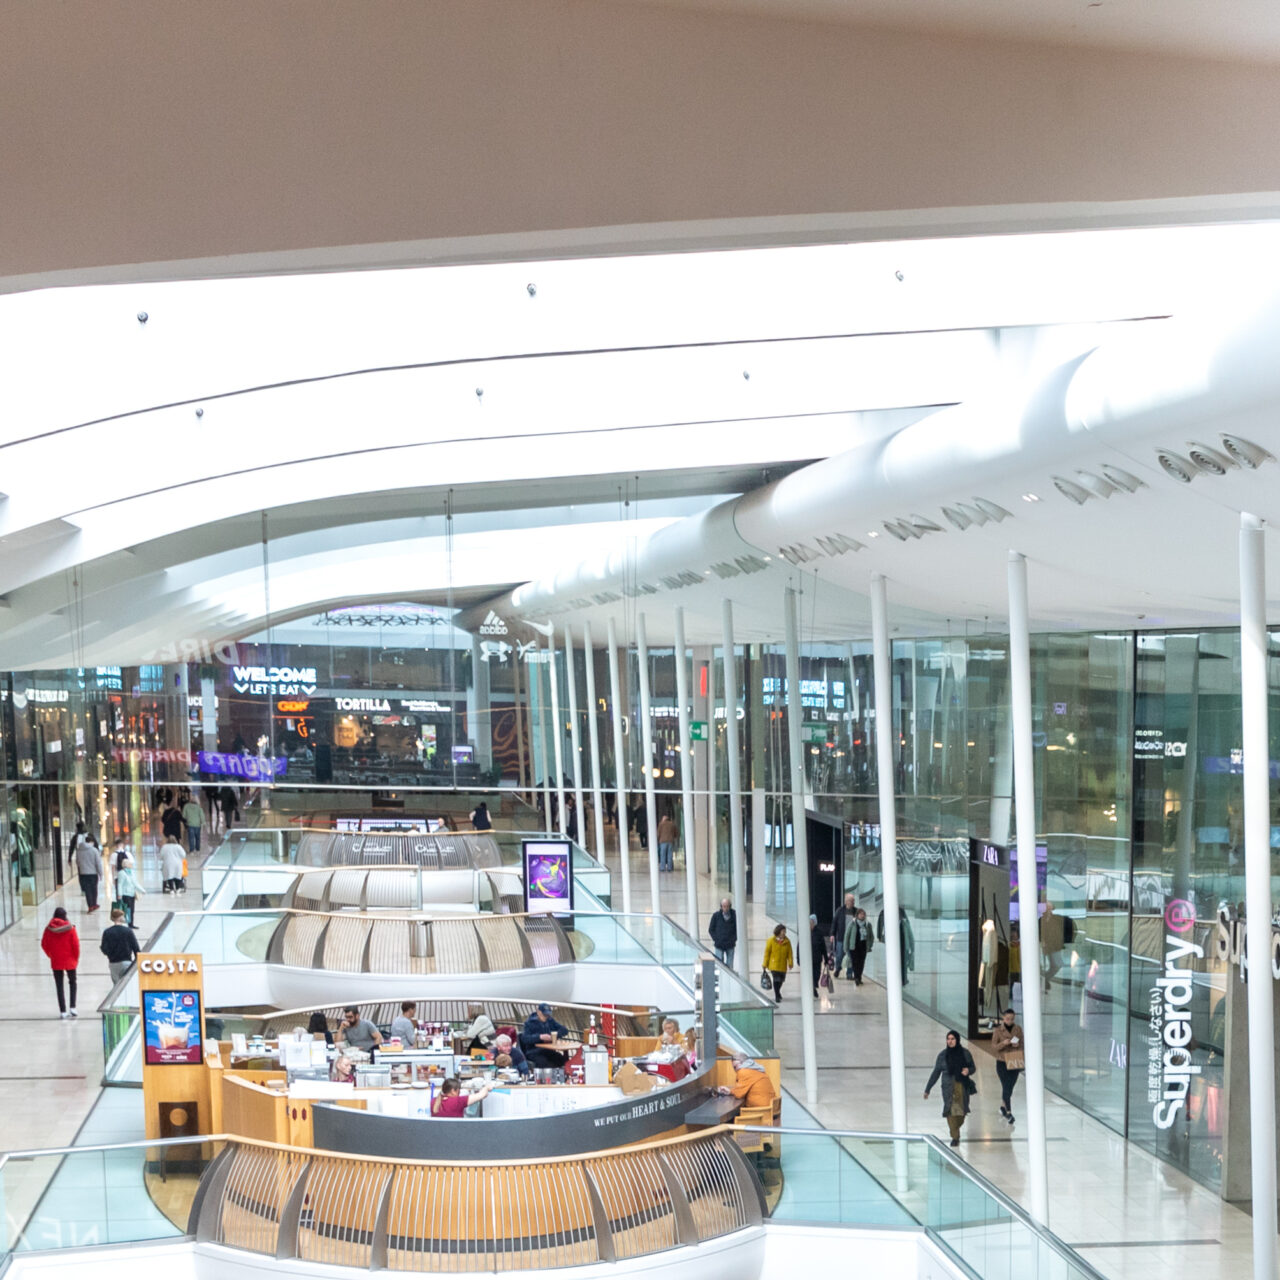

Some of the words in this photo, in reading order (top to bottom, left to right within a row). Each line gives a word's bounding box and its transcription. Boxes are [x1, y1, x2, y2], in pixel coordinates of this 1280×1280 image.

[232, 666, 317, 683] WELCOME
[279, 684, 299, 695] EAT
[335, 698, 391, 711] TORTILLA
[983, 845, 999, 867] ZARA
[141, 960, 198, 974] COSTA
[594, 1118, 605, 1127] WE
[606, 1115, 619, 1125] PUT
[632, 1100, 659, 1119] HEART
[660, 1098, 665, 1110] &
[666, 1093, 682, 1109] SOUL
